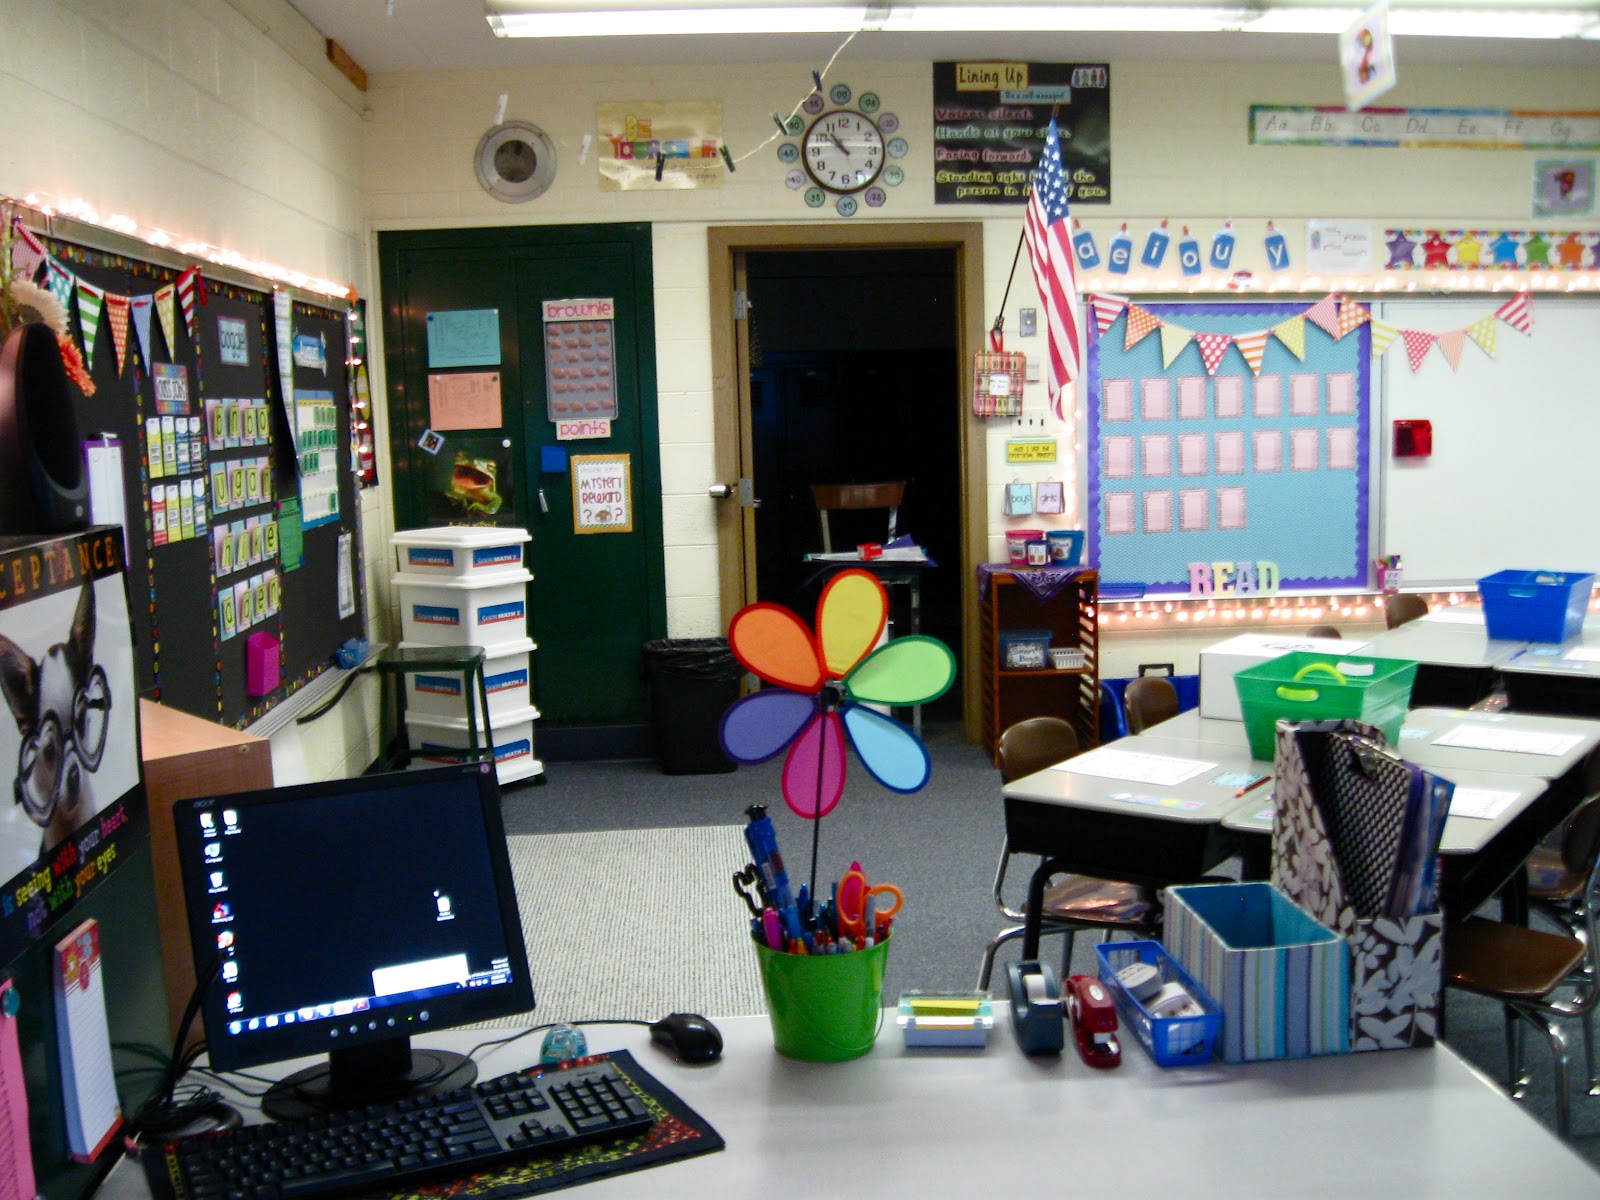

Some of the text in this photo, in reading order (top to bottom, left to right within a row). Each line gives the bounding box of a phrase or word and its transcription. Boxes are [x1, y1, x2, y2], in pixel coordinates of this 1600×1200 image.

[959, 67, 1023, 88] Lining Up
[826, 123, 836, 132] 11
[838, 118, 850, 129] 12
[864, 133, 872, 142] 2
[811, 147, 820, 156] 9
[869, 146, 877, 155] 3
[816, 161, 825, 171] 8
[865, 160, 873, 169] 4
[828, 171, 836, 180] 7
[841, 175, 850, 184] 6
[937, 171, 993, 183] Standing
[997, 172, 1025, 183] right
[1074, 171, 1095, 182] the
[957, 186, 1000, 197] person
[1078, 241, 1283, 267] a e i o u y
[547, 301, 611, 318] brownie
[560, 421, 608, 436] points
[1011, 494, 1031, 505] boys
[1039, 494, 1057, 505] girls
[1187, 560, 1280, 598] READ
[504, 750, 521, 758] MATH
[15, 865, 53, 908] seeing
[78, 828, 100, 864] your
